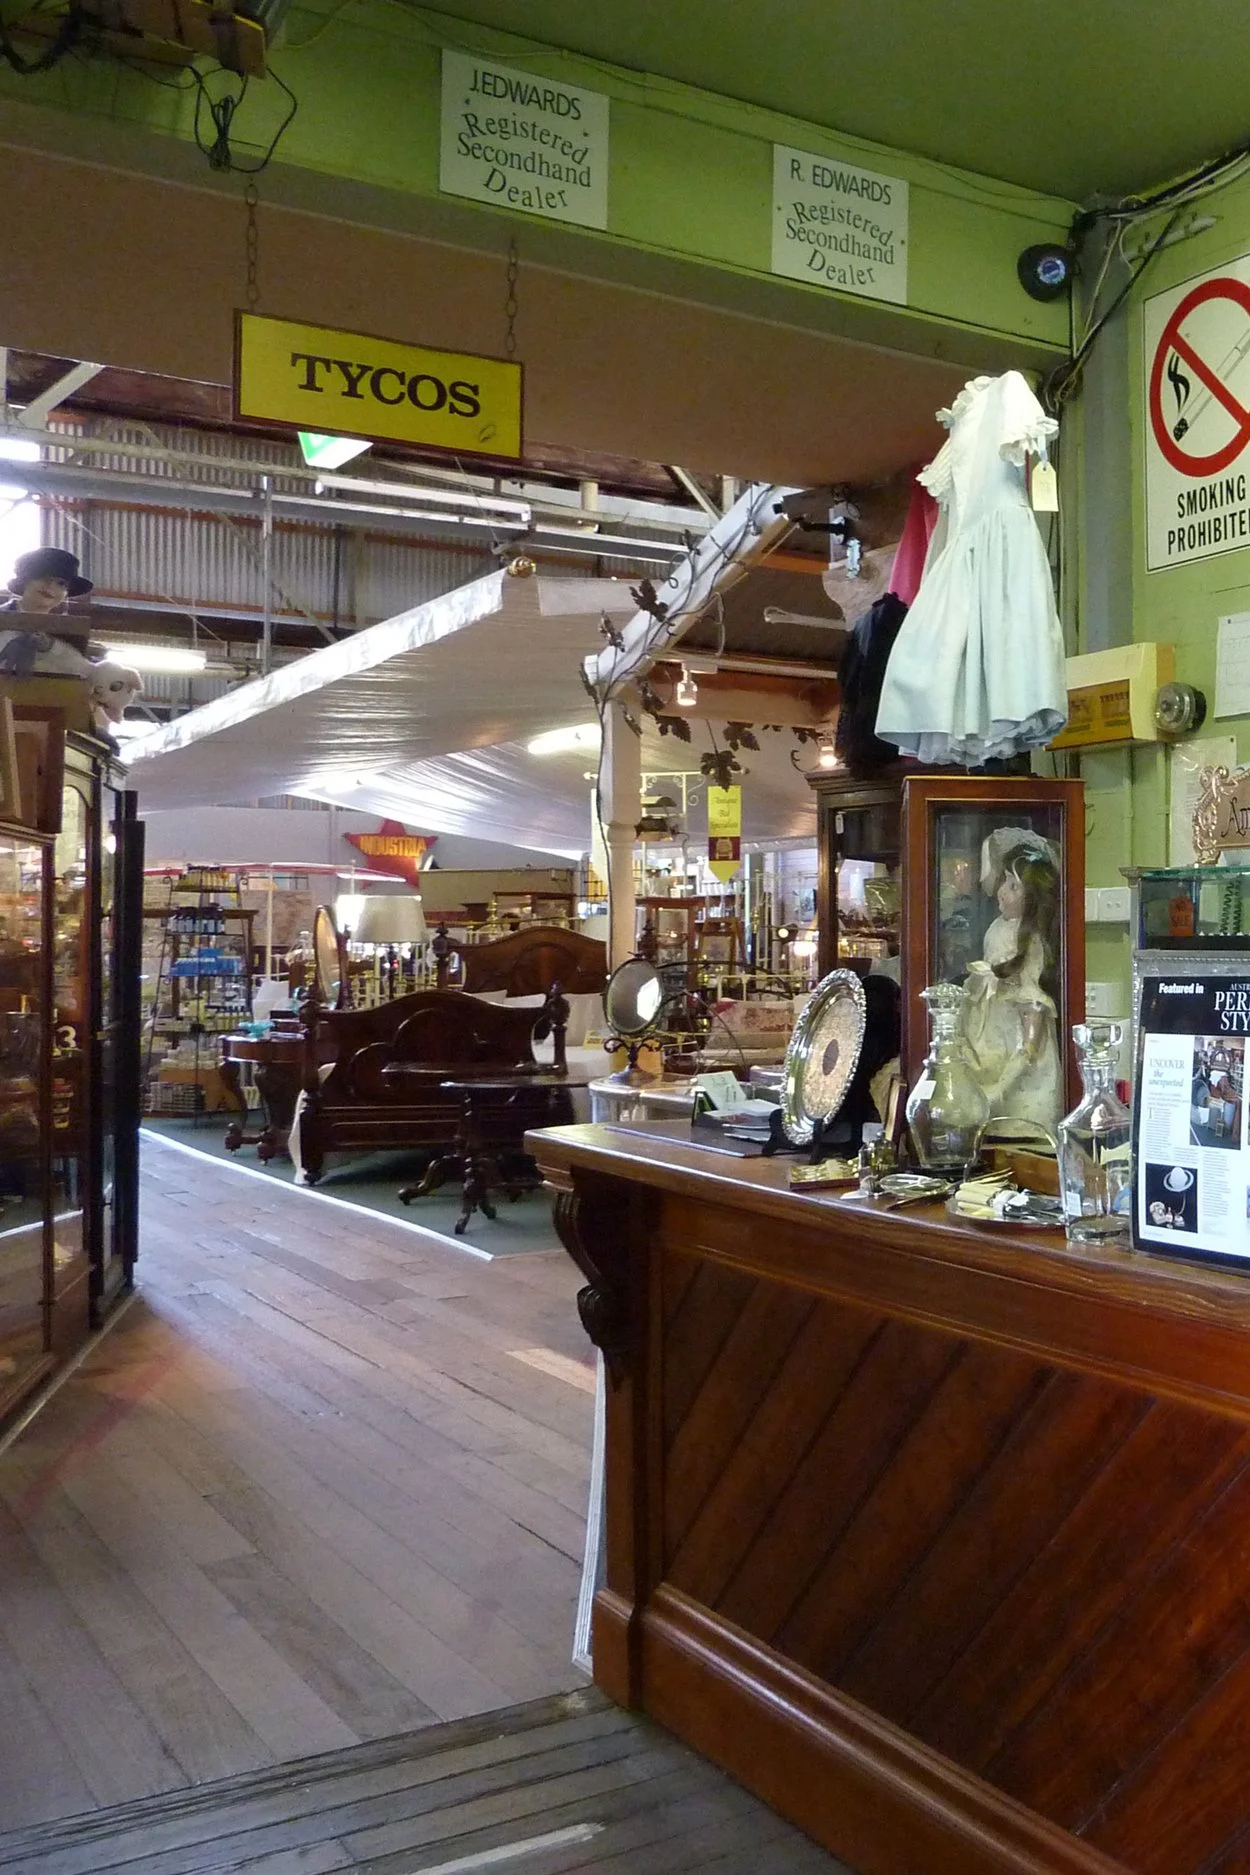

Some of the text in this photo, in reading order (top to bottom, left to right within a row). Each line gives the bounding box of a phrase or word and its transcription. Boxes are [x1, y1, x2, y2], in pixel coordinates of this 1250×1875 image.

[456, 132, 591, 188] Secondhand
[462, 112, 589, 166] Registered
[482, 167, 569, 210] Dealer
[811, 165, 892, 205] EDWARDS
[784, 218, 895, 266] Secondhand
[792, 201, 894, 245] Registered
[806, 249, 877, 286] Dealer
[290, 352, 481, 418] TYCOS
[1177, 474, 1246, 519] SMOKING
[1159, 983, 1204, 994] Featured in
